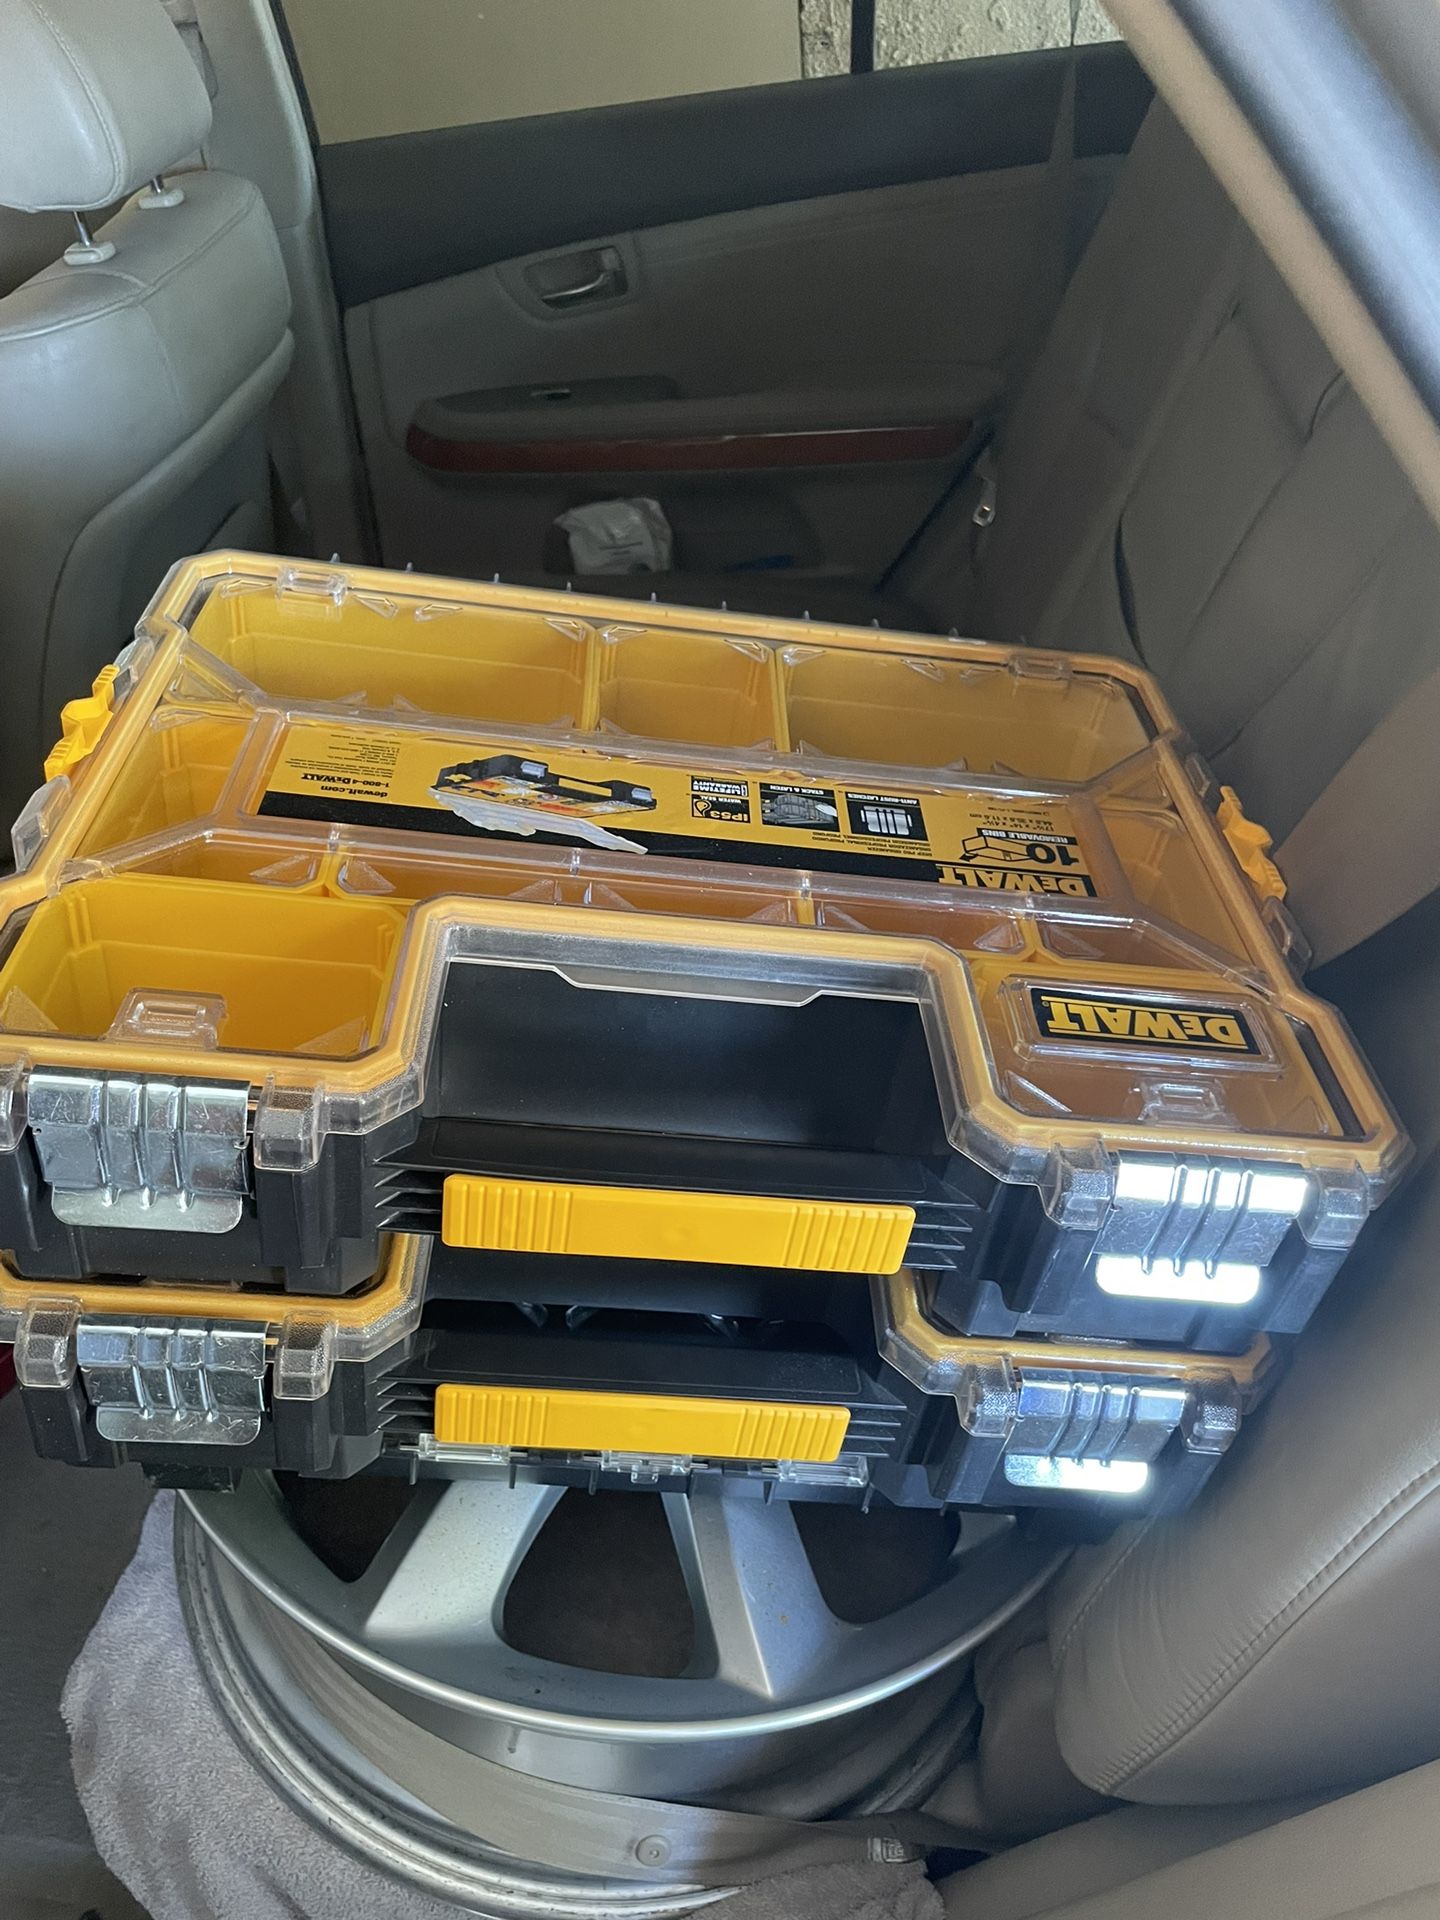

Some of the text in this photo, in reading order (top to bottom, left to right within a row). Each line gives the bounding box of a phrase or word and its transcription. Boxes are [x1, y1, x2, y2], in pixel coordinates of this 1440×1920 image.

[693, 781, 740, 789] WARRANTY
[693, 786, 740, 795] LIFETIME
[321, 786, 387, 798] dewalt.com
[848, 793, 917, 804] ANTI-RUST LATCHES
[710, 810, 748, 822] IP53
[982, 829, 1068, 844] REMOVABLE BINS
[1026, 843, 1079, 866] 10
[938, 867, 1087, 896] DEWALT
[1045, 1001, 1246, 1046] DEWALT
